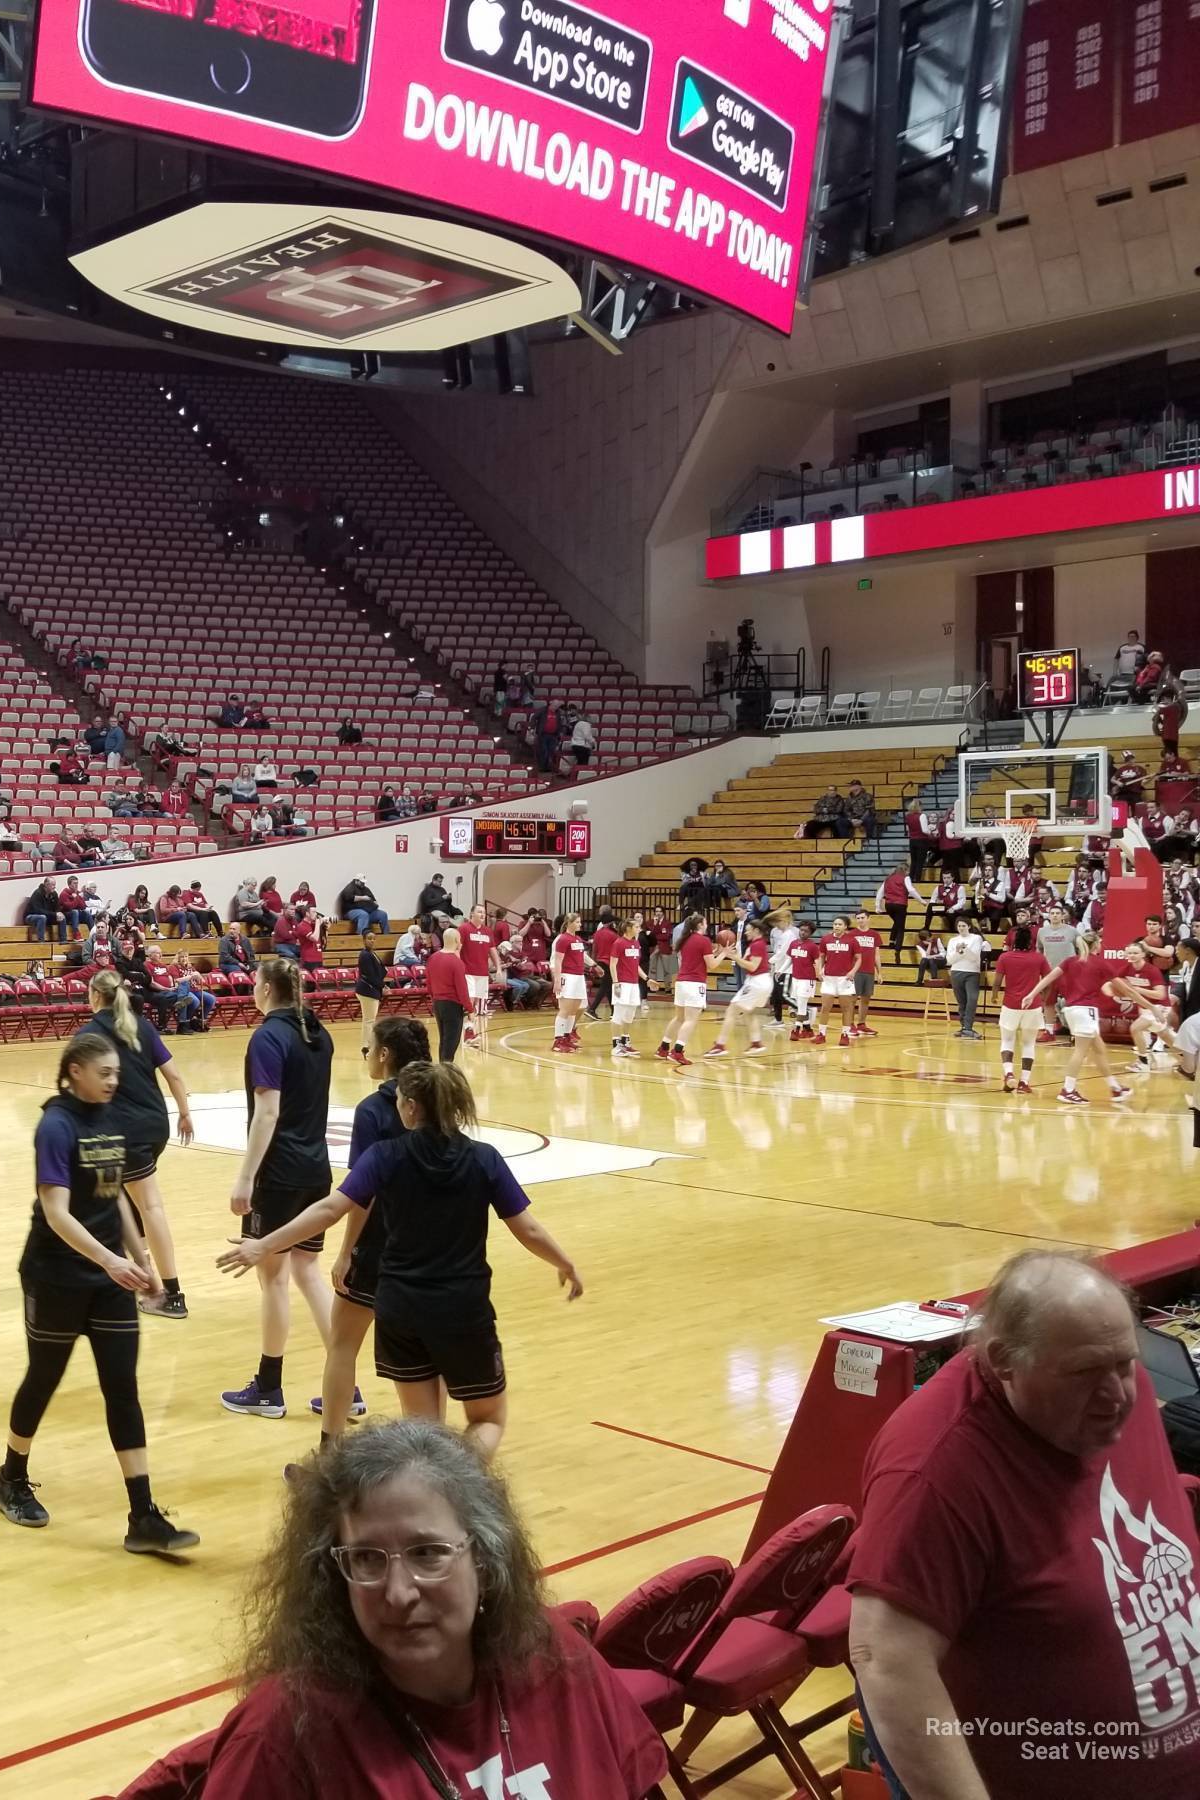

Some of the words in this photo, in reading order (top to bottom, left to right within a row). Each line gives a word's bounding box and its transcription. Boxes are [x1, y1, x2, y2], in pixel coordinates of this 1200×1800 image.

[520, 0, 591, 49] Download
[594, 30, 611, 53] on
[613, 38, 635, 67] the
[514, 30, 569, 90] App
[569, 55, 632, 110] Store
[716, 94, 733, 119] GET
[711, 119, 759, 175] Google
[759, 143, 785, 195] Play
[402, 82, 614, 201] DOWNLOAD
[620, 158, 676, 228] THE
[674, 187, 725, 247] APP
[727, 210, 792, 288] TODAY!
[168, 231, 351, 296] HEALTH
[1164, 469, 1200, 510] IN
[1026, 656, 1072, 672] 46:49
[1033, 673, 1066, 701] 30
[453, 829, 466, 838] GO
[475, 821, 503, 830] INDIANA
[572, 830, 585, 840] 200
[556, 836, 563, 850] 0
[841, 1343, 874, 1361] CAMERON
[841, 1360, 871, 1376] MAGGIE
[1112, 1571, 1197, 1638] LIGHT
[1135, 1662, 1200, 1728] U
